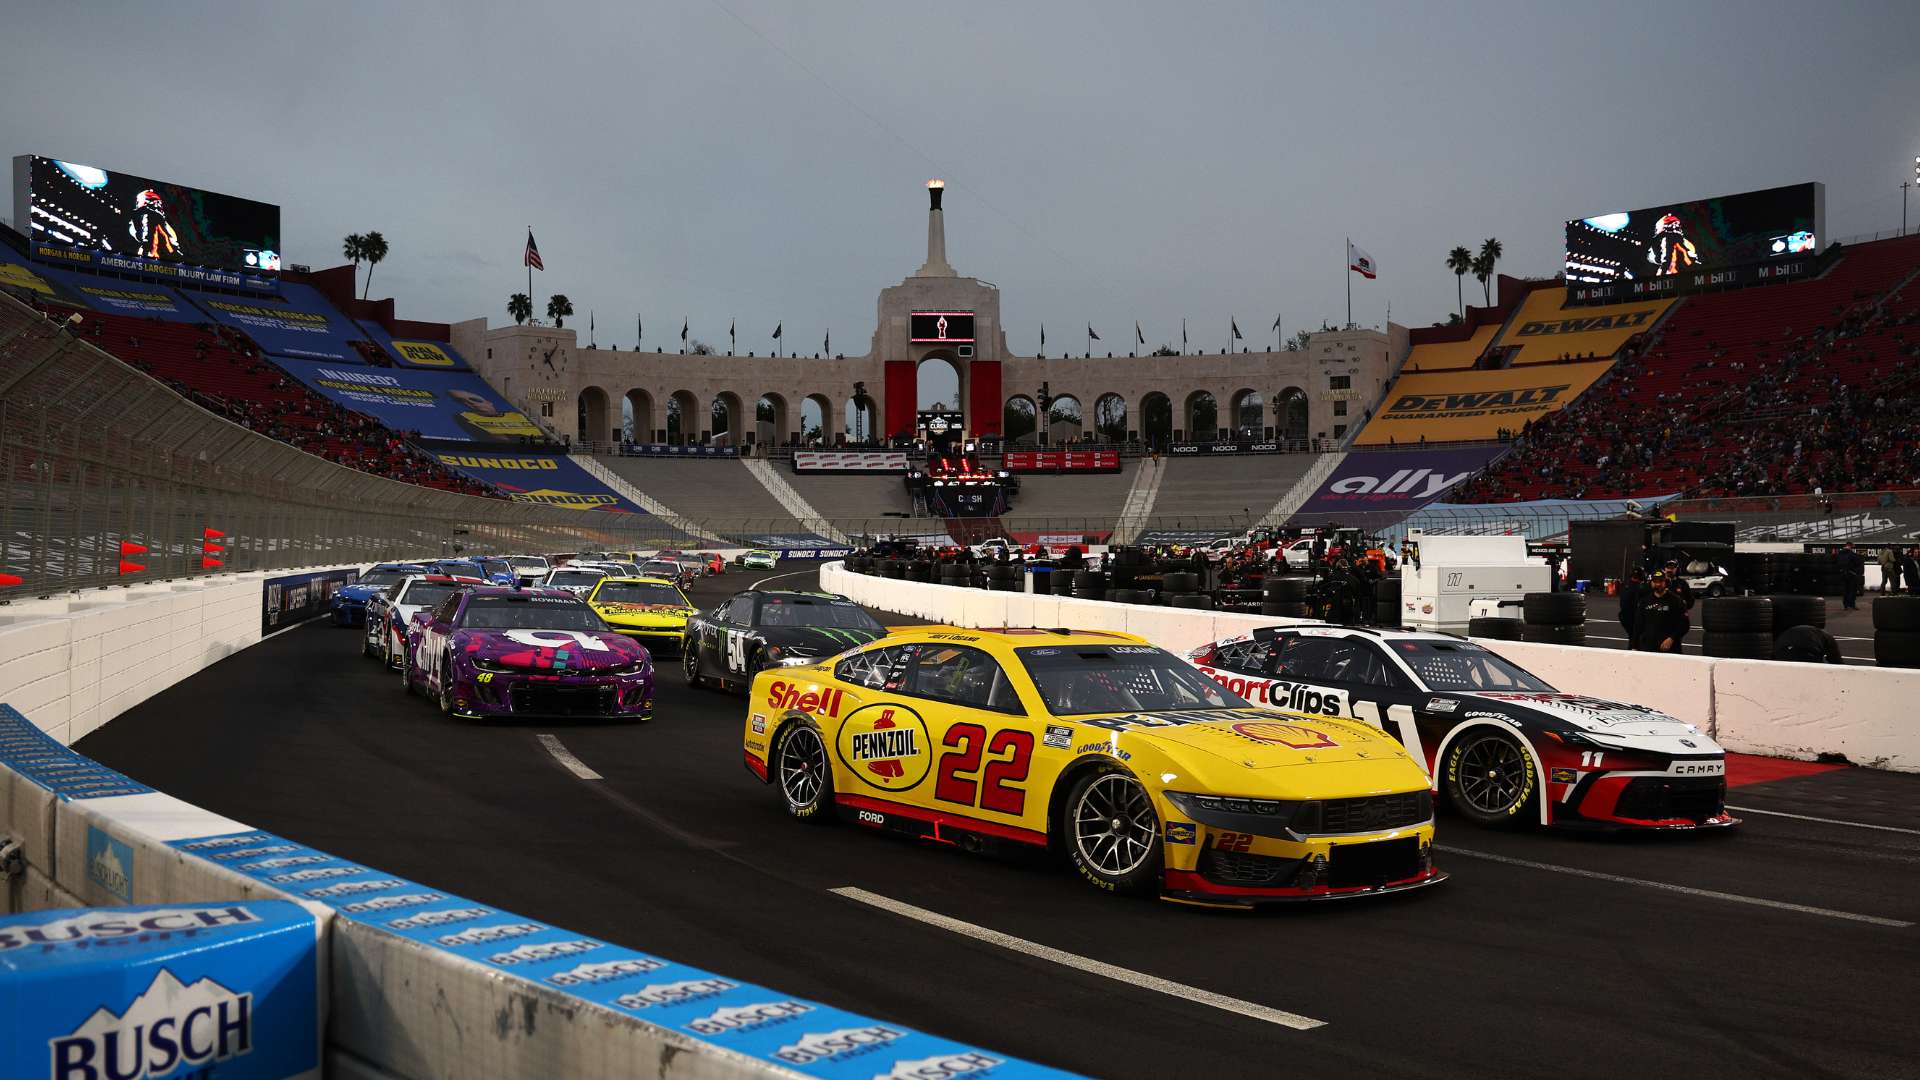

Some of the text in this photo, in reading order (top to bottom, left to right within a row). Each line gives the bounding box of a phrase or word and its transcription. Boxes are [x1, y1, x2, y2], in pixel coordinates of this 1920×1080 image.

[101, 256, 143, 271] AMERICA'S
[144, 262, 177, 276] LARGEST
[178, 267, 204, 280] INJURY
[205, 271, 221, 282] LAW
[222, 274, 240, 285] FIRM
[1516, 310, 1655, 337] DEWALT
[1389, 384, 1570, 412] DEWALT
[1382, 410, 1486, 421] GUARANTEED
[1251, 443, 1277, 451] NOCO
[438, 454, 558, 470] SUNOCO
[1330, 468, 1478, 499] ally
[788, 550, 816, 558] SUNOCO
[819, 549, 848, 558] SUNOCO
[1481, 608, 1488, 617] 11
[727, 629, 747, 675] 54
[476, 672, 494, 683] 48
[768, 681, 844, 718] Shell
[1464, 711, 1523, 728] GOODYEAR
[852, 729, 918, 761] PENNZOIL
[1076, 740, 1132, 761] GOODYAR
[934, 722, 1035, 817] 22
[1448, 744, 1463, 782] EAGLE
[1581, 750, 1605, 768] 11
[1675, 764, 1724, 775] CAMRY
[1507, 745, 1535, 817] GOODYEAR
[859, 810, 884, 824] FORD
[1219, 832, 1254, 852] 22
[343, 893, 440, 912] BUSCH
[386, 908, 492, 929] BUSCH
[436, 923, 545, 947] BUSCH
[489, 939, 601, 964] BUSCH
[547, 959, 665, 985] BUSCH
[615, 979, 735, 1009] BUSCH
[686, 1000, 810, 1034] BUSCH
[53, 996, 250, 1080] BUSCH
[775, 1025, 902, 1063] BUSCH
